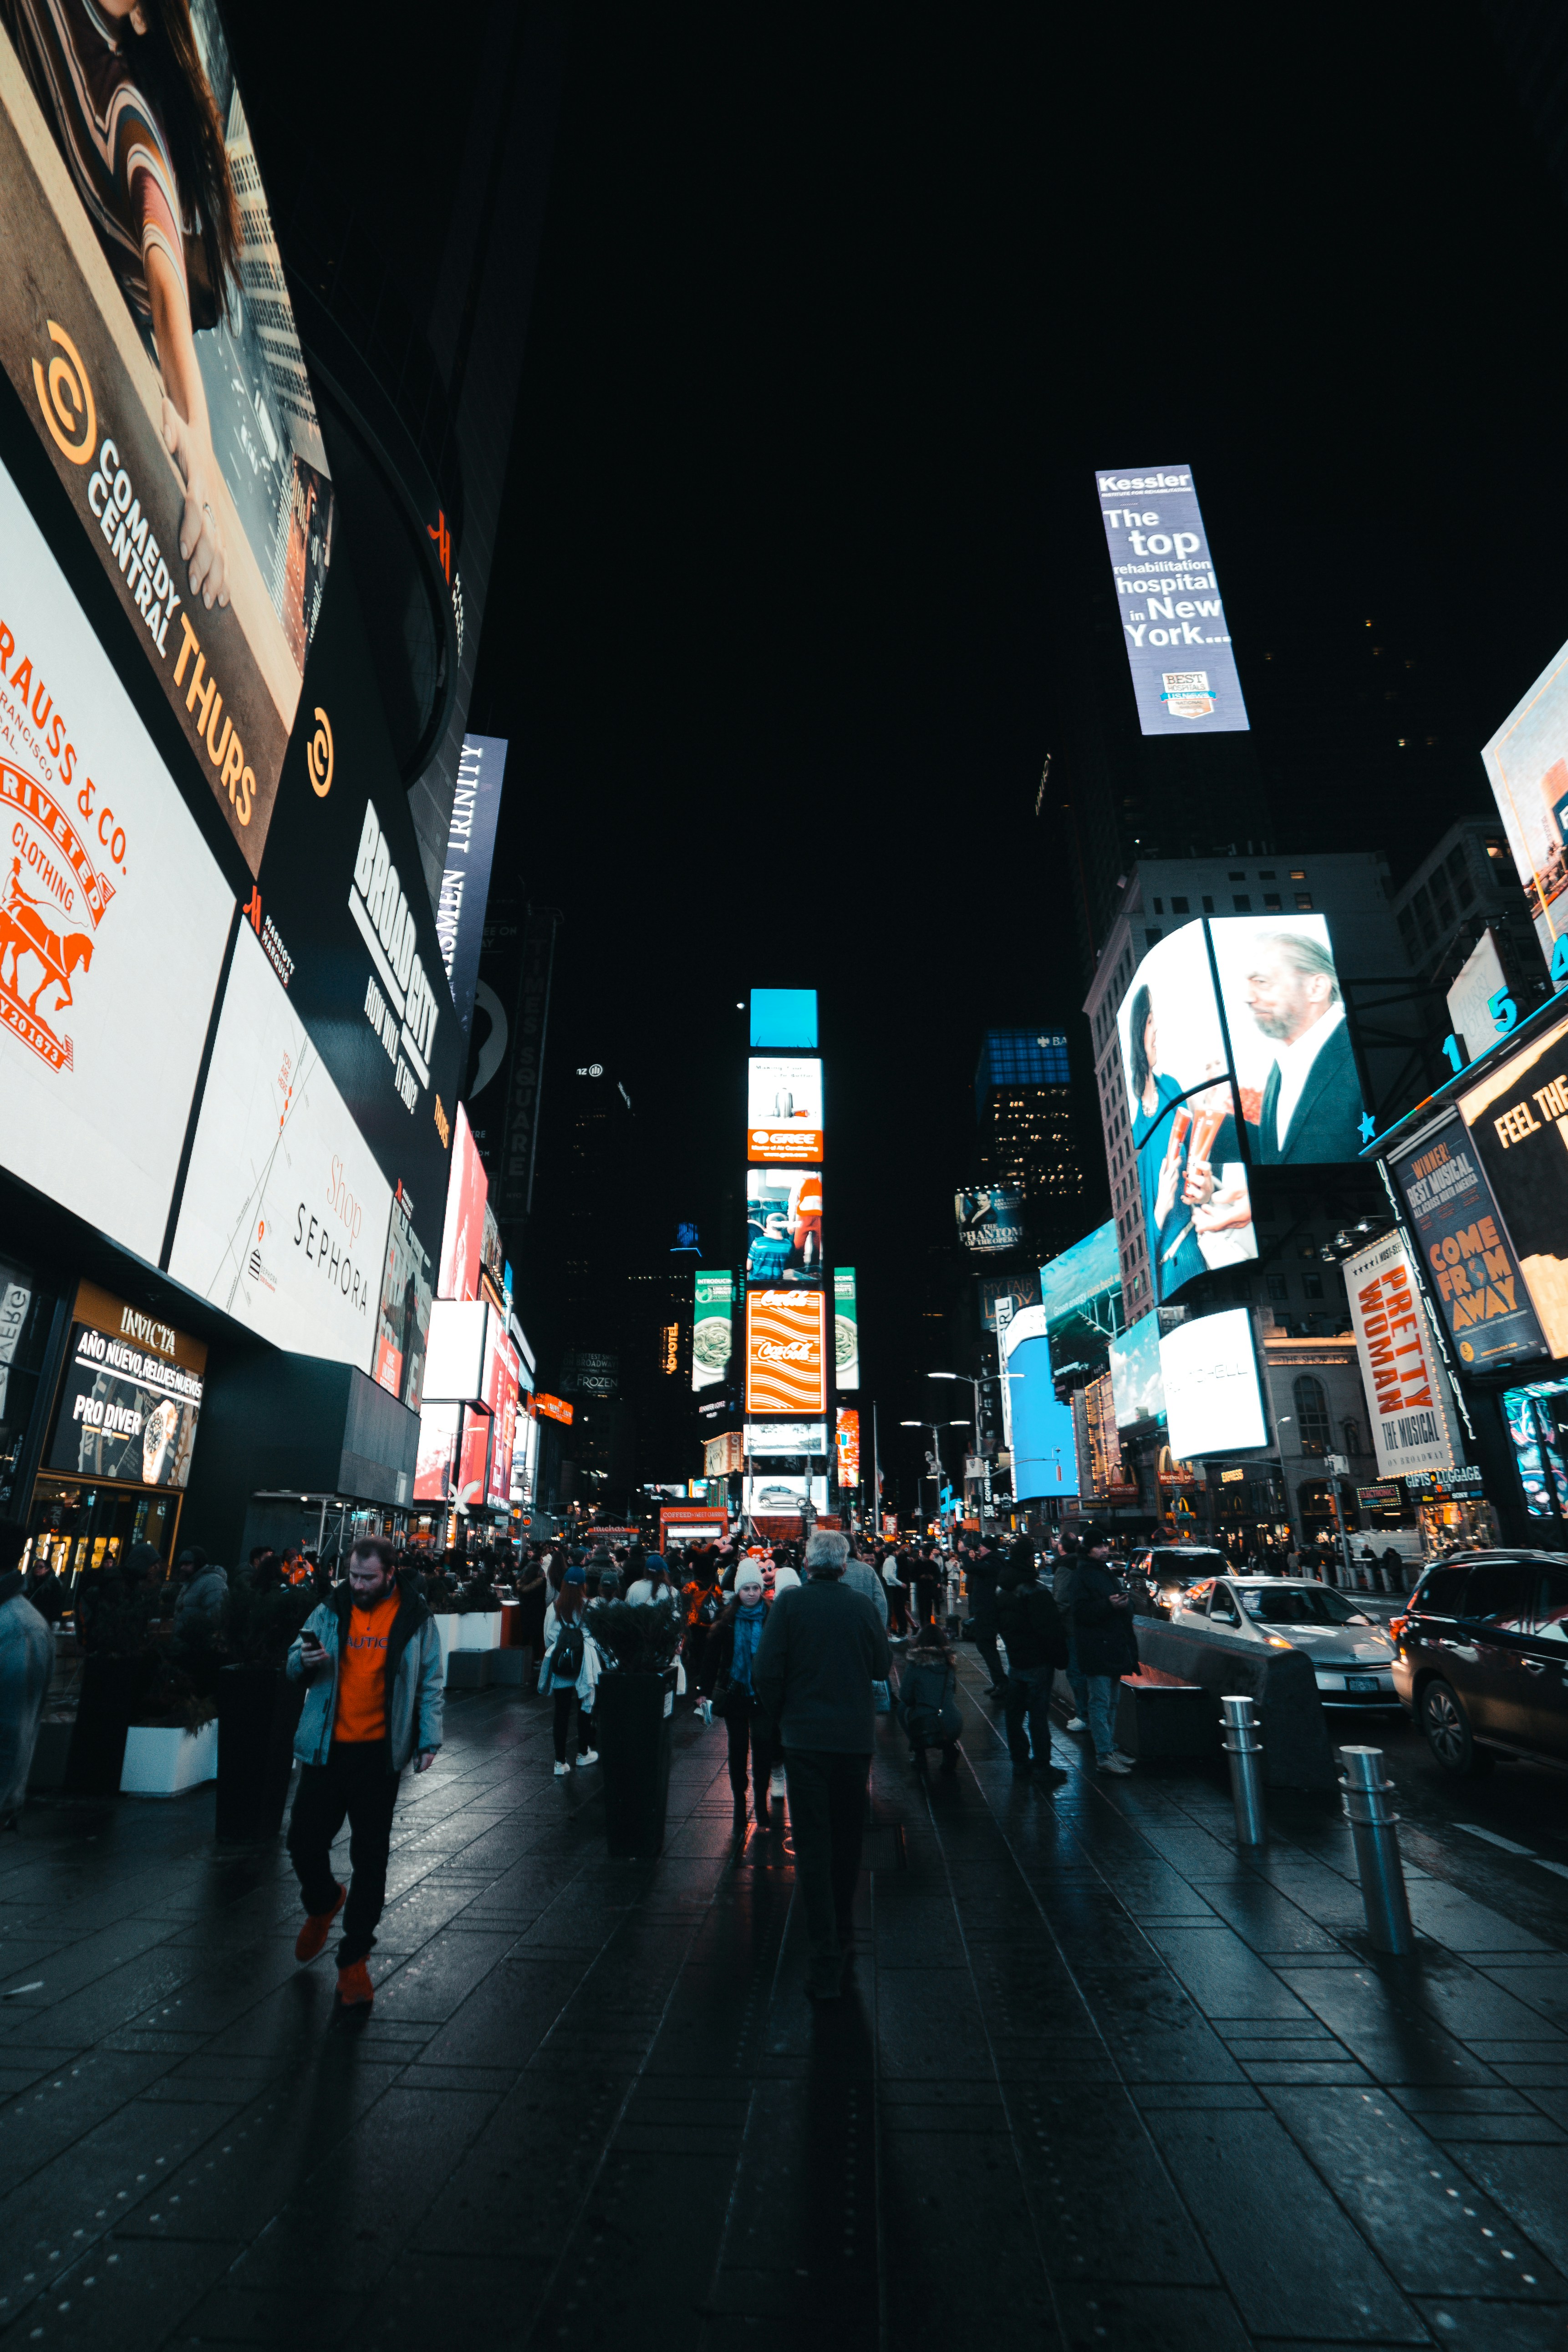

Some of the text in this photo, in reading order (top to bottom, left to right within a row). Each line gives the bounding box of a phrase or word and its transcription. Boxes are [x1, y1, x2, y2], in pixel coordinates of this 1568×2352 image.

[1098, 472, 1192, 492] Kessler
[100, 438, 181, 617] COMEDY
[1103, 508, 1160, 528] The
[87, 471, 168, 658] CENTRAL
[1128, 529, 1201, 560] top
[1114, 560, 1212, 575] rehabilitation
[1116, 572, 1217, 596] hospital
[1129, 596, 1222, 622] in New
[1124, 622, 1232, 647] York...
[1166, 674, 1203, 684] BEST
[172, 612, 256, 826] THURS
[448, 743, 484, 854] TRINITY
[3, 769, 101, 910] RIVETED
[77, 777, 96, 824] &
[98, 808, 127, 876] CO.
[12, 822, 74, 913] CLOTHING
[265, 915, 295, 975] MARRIOTT
[354, 798, 439, 1065] BROAD CITY
[262, 930, 289, 984] MARQUIS
[28, 1027, 58, 1062] 1873
[283, 1049, 292, 1069] YOU
[364, 976, 418, 1115] HOW WILL IT END?
[277, 1074, 287, 1095] HERE
[280, 1064, 289, 1081] ARE
[434, 1093, 450, 1149] THURS
[508, 1048, 537, 1177] SQUARE
[1493, 1074, 1568, 1149] FEEL THE
[769, 1133, 816, 1144] GREE
[1406, 1178, 1431, 1208] BEST
[1427, 1152, 1474, 1195] MUSICAL
[1411, 1141, 1451, 1180] WINNER!
[326, 1155, 362, 1249] Shop
[959, 1226, 1023, 1242] PHANTOM
[1429, 1215, 1501, 1272] COME
[293, 1201, 368, 1316] SEPHORA
[983, 1278, 1034, 1296] MY FAIR
[1069, 1292, 1086, 1308] energy
[1100, 1274, 1114, 1290] best
[1452, 1275, 1519, 1332] AWAY
[120, 1306, 175, 1356] INVICTA
[666, 1322, 679, 1375] NOVOTEL
[758, 1342, 814, 1361] Coca-Cola
[1357, 1277, 1404, 1415] WOMAN
[1380, 1263, 1434, 1408] PRETTY
[77, 1330, 203, 1399] AÑO NUEVO, RELOJES NUEVOS
[1280, 1355, 1298, 1364] THE
[1302, 1355, 1328, 1364] SHOW
[577, 1374, 618, 1390] FROZEN
[73, 1394, 143, 1436] PRO DIVER
[1381, 1410, 1440, 1451] THE MUSICAL
[1387, 1450, 1444, 1467] ON BROADWAY
[1405, 1466, 1483, 1488] GIFTS LUGGAGE
[1359, 1488, 1396, 1498] ELECTRONICS
[593, 1524, 626, 1532] muchas
